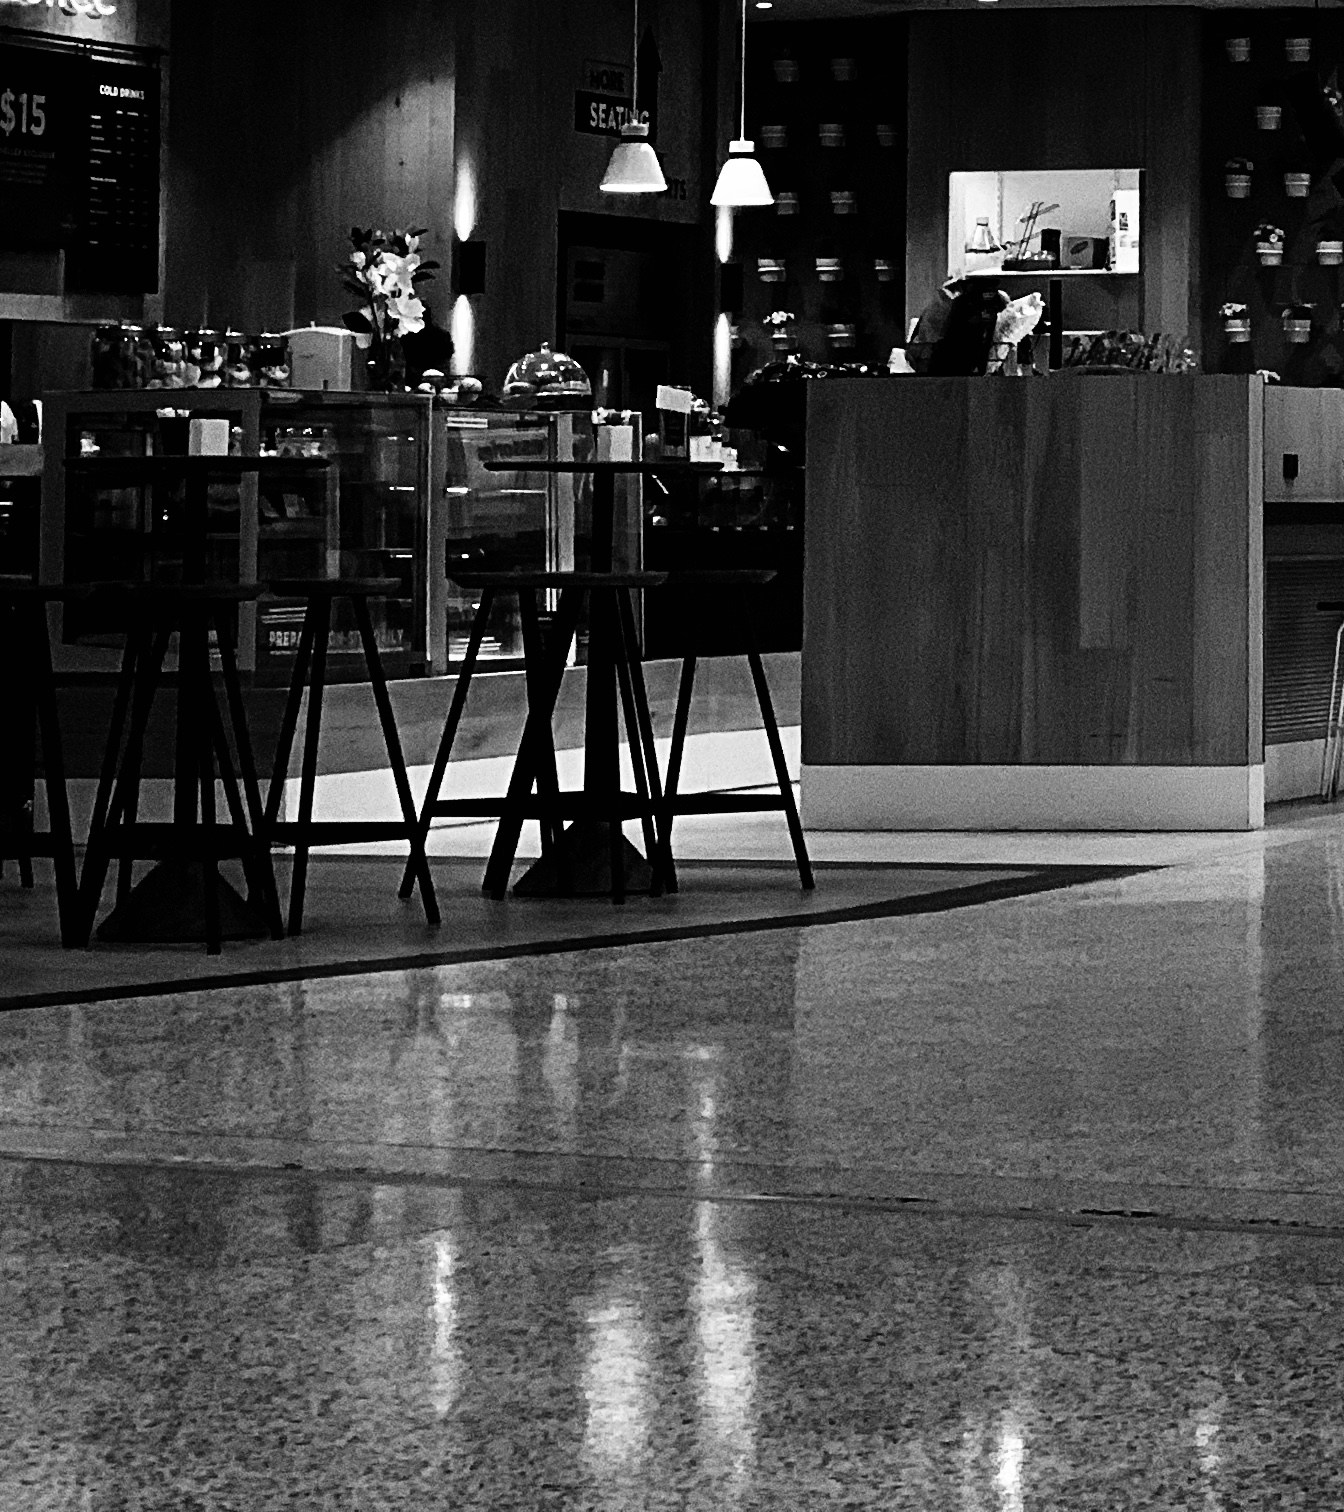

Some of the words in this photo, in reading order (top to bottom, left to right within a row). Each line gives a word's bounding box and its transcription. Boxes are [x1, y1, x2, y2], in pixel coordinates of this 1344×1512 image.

[99, 84, 119, 97] COLD
[119, 87, 145, 101] DRINKS
[0, 88, 46, 136] $15
